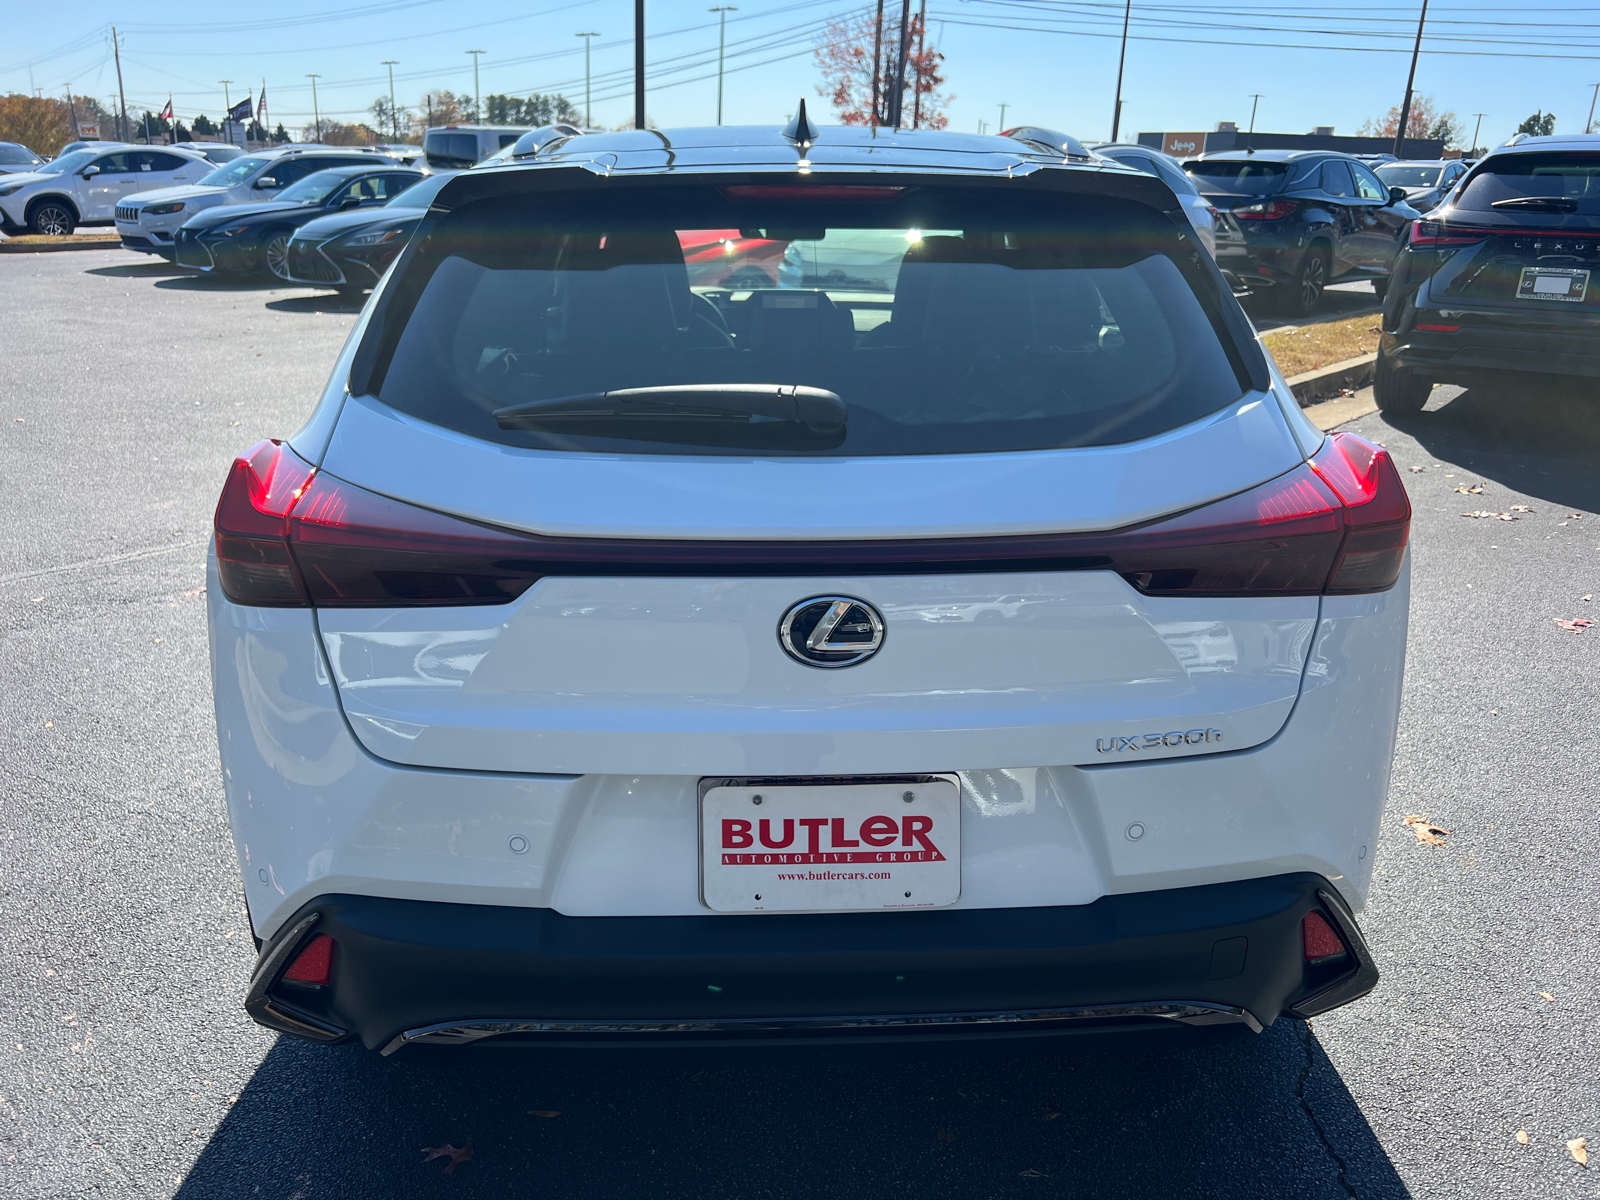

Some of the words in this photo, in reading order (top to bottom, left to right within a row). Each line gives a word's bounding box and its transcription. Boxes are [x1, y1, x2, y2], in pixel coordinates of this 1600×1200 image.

[1170, 139, 1196, 153] Jeep
[1096, 735, 1139, 753] UX
[1142, 728, 1223, 749] 300h
[723, 853, 853, 864] AUTOMOTIVE
[875, 851, 939, 862] GROUP
[777, 870, 892, 881] www.butlercars.com
